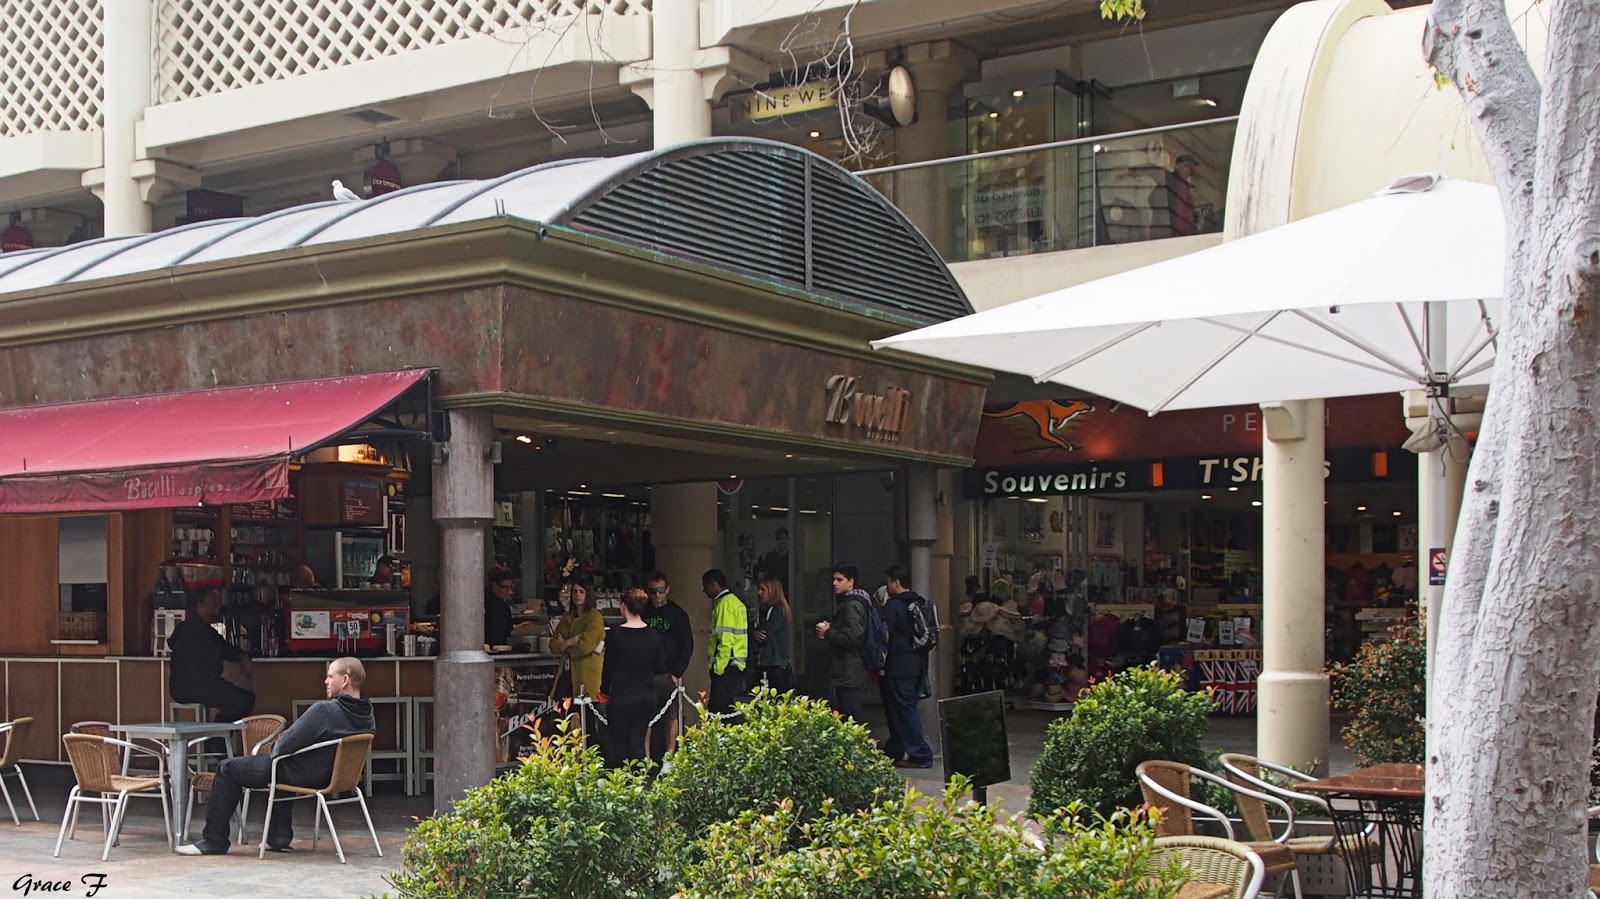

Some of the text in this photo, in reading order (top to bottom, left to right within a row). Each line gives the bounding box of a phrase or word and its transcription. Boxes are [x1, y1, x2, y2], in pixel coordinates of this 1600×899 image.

[741, 94, 790, 116] NINE
[984, 468, 1127, 494] Souvenirs
[1199, 456, 1331, 484] T'Shs
[124, 475, 175, 500] Bocelli
[349, 621, 358, 631] 50
